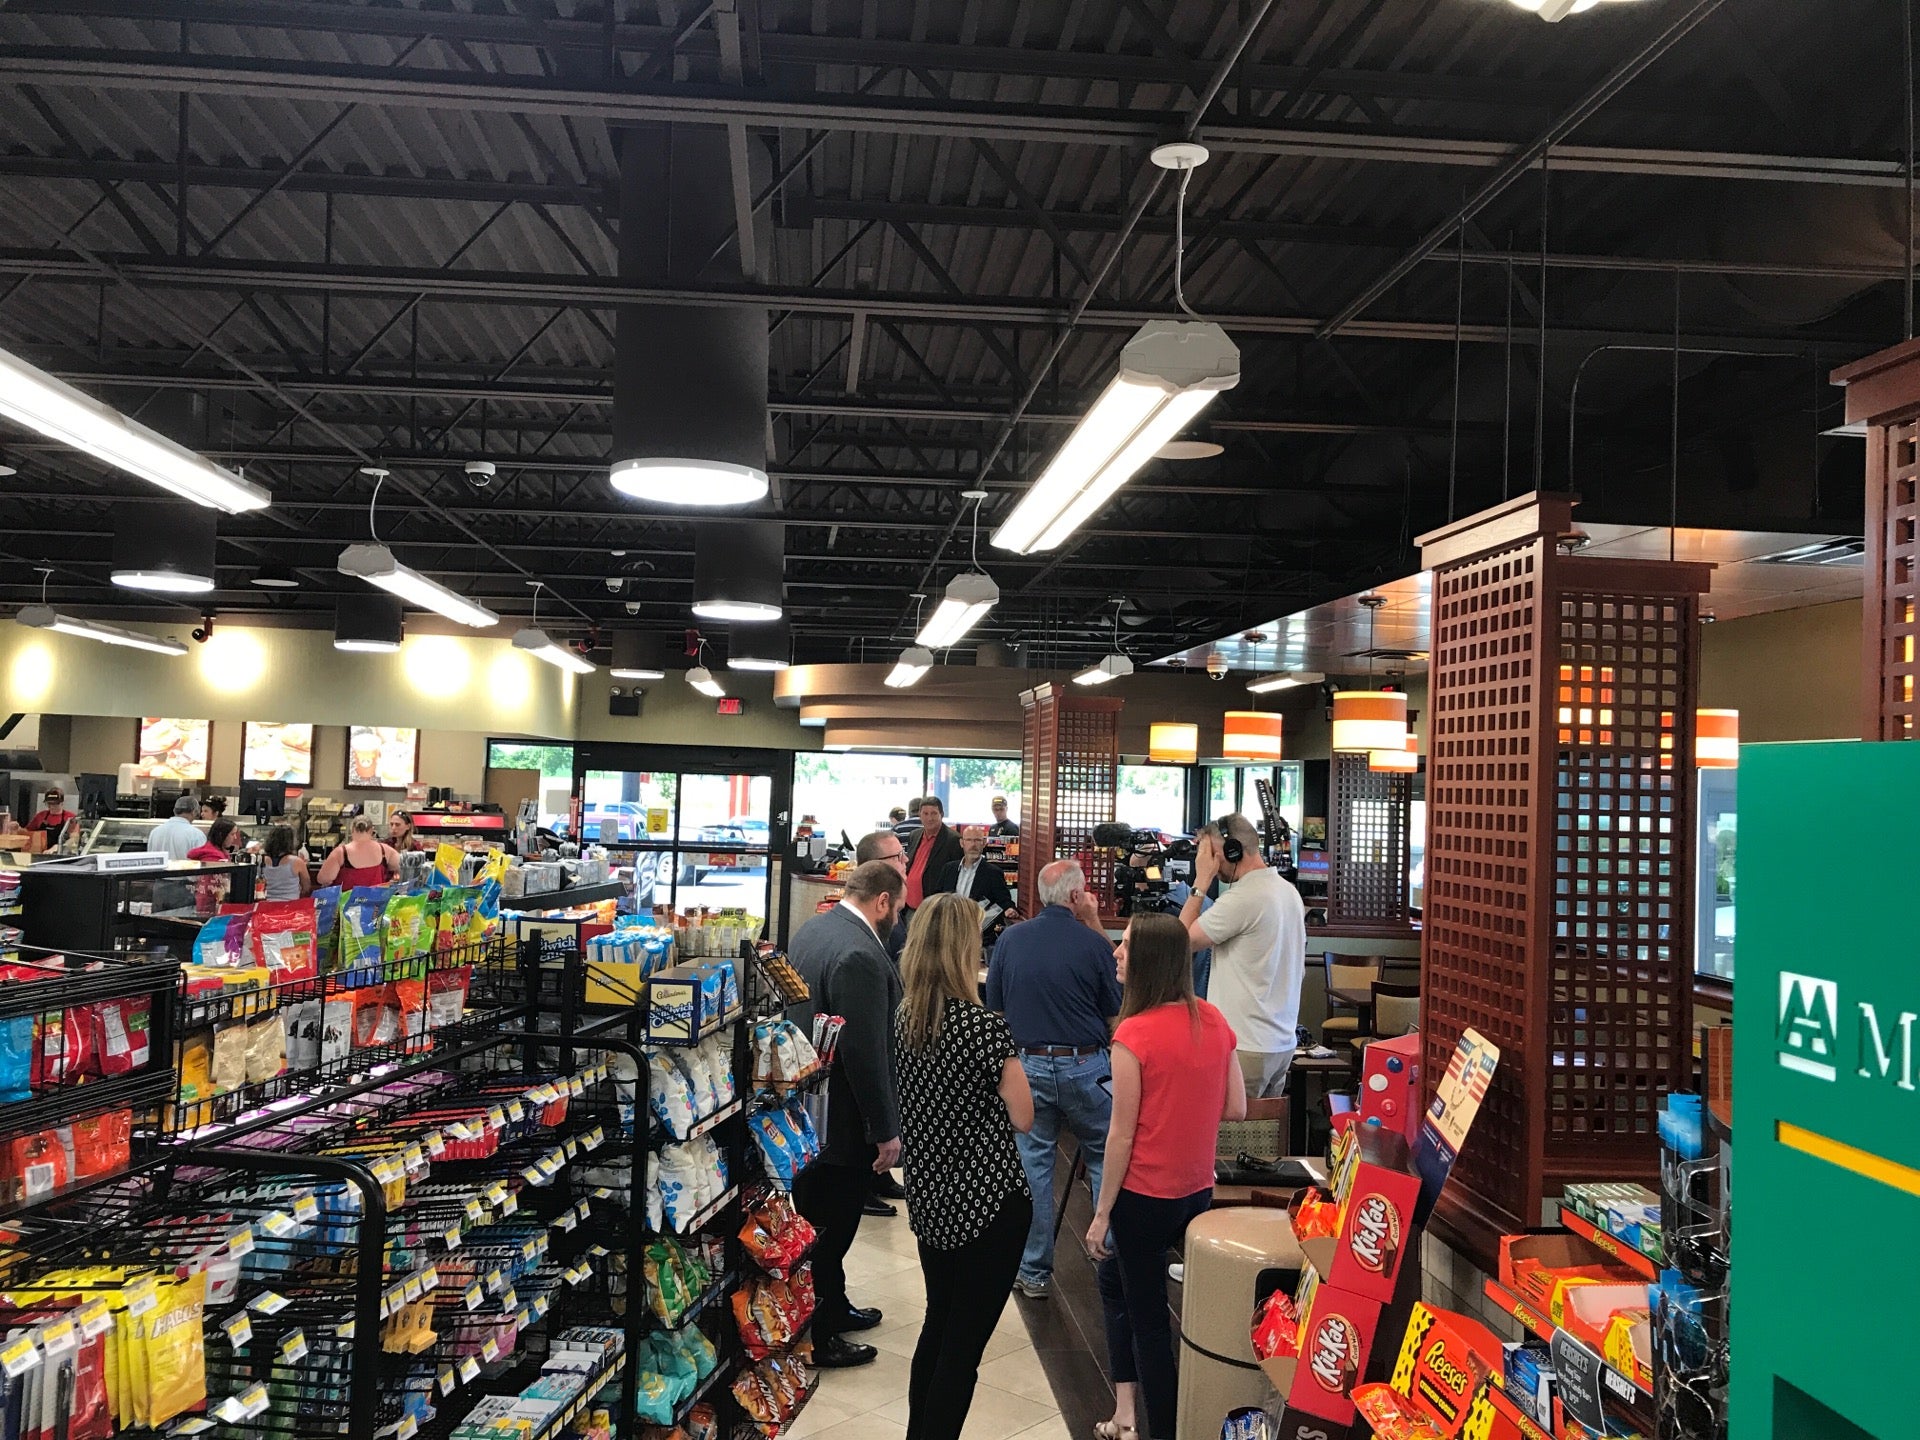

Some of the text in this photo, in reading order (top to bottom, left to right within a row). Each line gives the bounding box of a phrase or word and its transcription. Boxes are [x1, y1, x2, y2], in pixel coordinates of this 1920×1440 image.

[720, 698, 740, 713] EXIT
[1858, 1001, 1920, 1091] M
[151, 1301, 203, 1341] HALLS
[1513, 1303, 1537, 1330] Reese's
[1424, 1340, 1469, 1396] Reese's
[1560, 1339, 1590, 1374] HERSHEY'S
[1604, 1367, 1637, 1405] HERSHEY'S
